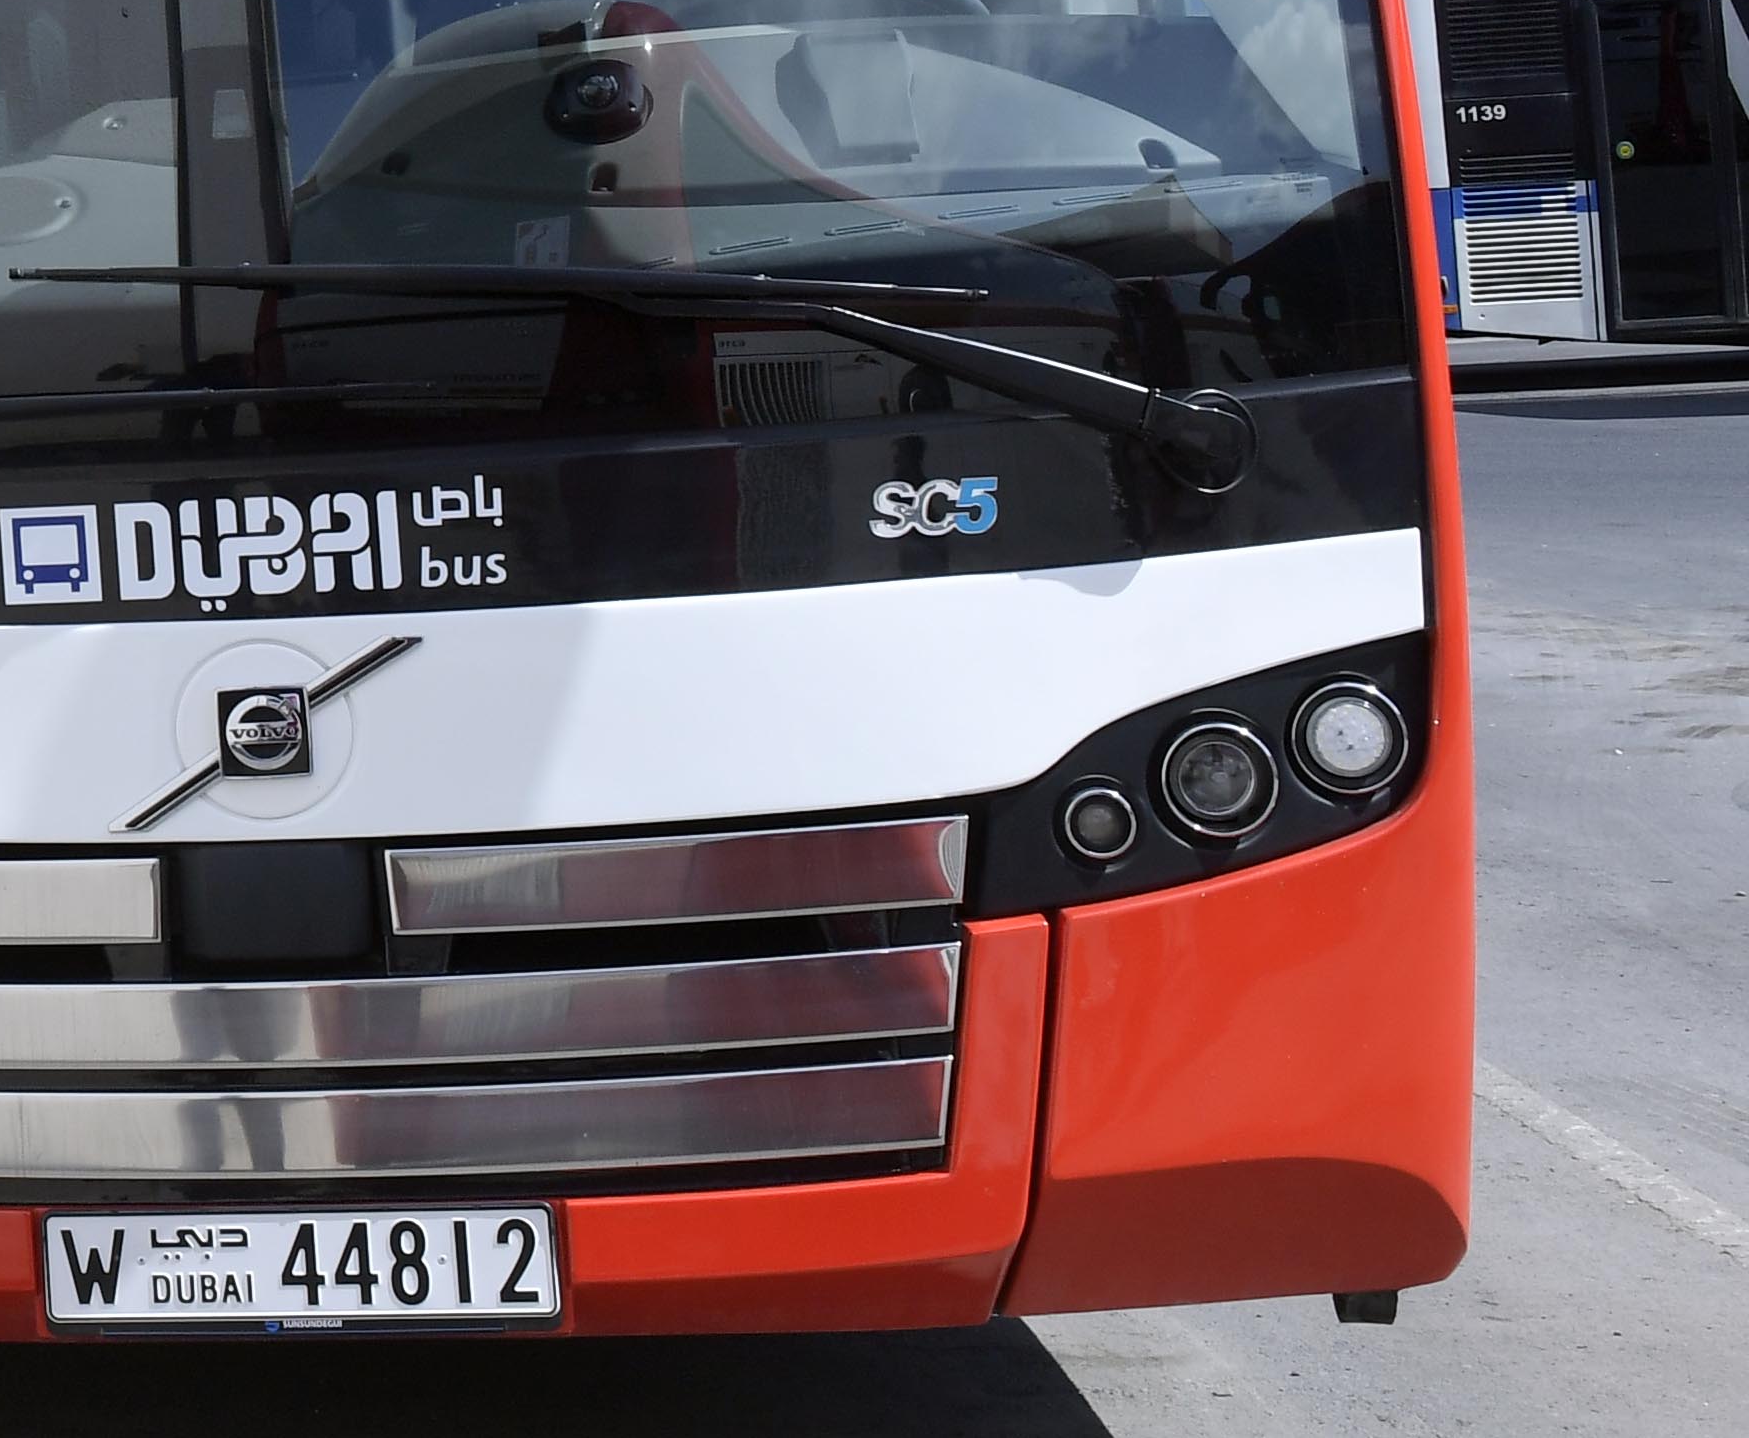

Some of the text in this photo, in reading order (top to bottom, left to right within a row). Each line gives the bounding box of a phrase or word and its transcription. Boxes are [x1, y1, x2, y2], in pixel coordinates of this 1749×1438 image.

[1456, 104, 1506, 123] 1139
[412, 474, 504, 528] باص
[868, 475, 999, 539] SC5
[113, 489, 403, 612] DUBAI
[420, 546, 508, 589] bus
[229, 723, 299, 740] VOLVO
[61, 1228, 125, 1305] W
[150, 1226, 251, 1262] دبي
[281, 1219, 540, 1307] 44812
[151, 1272, 255, 1305] DUBAI
